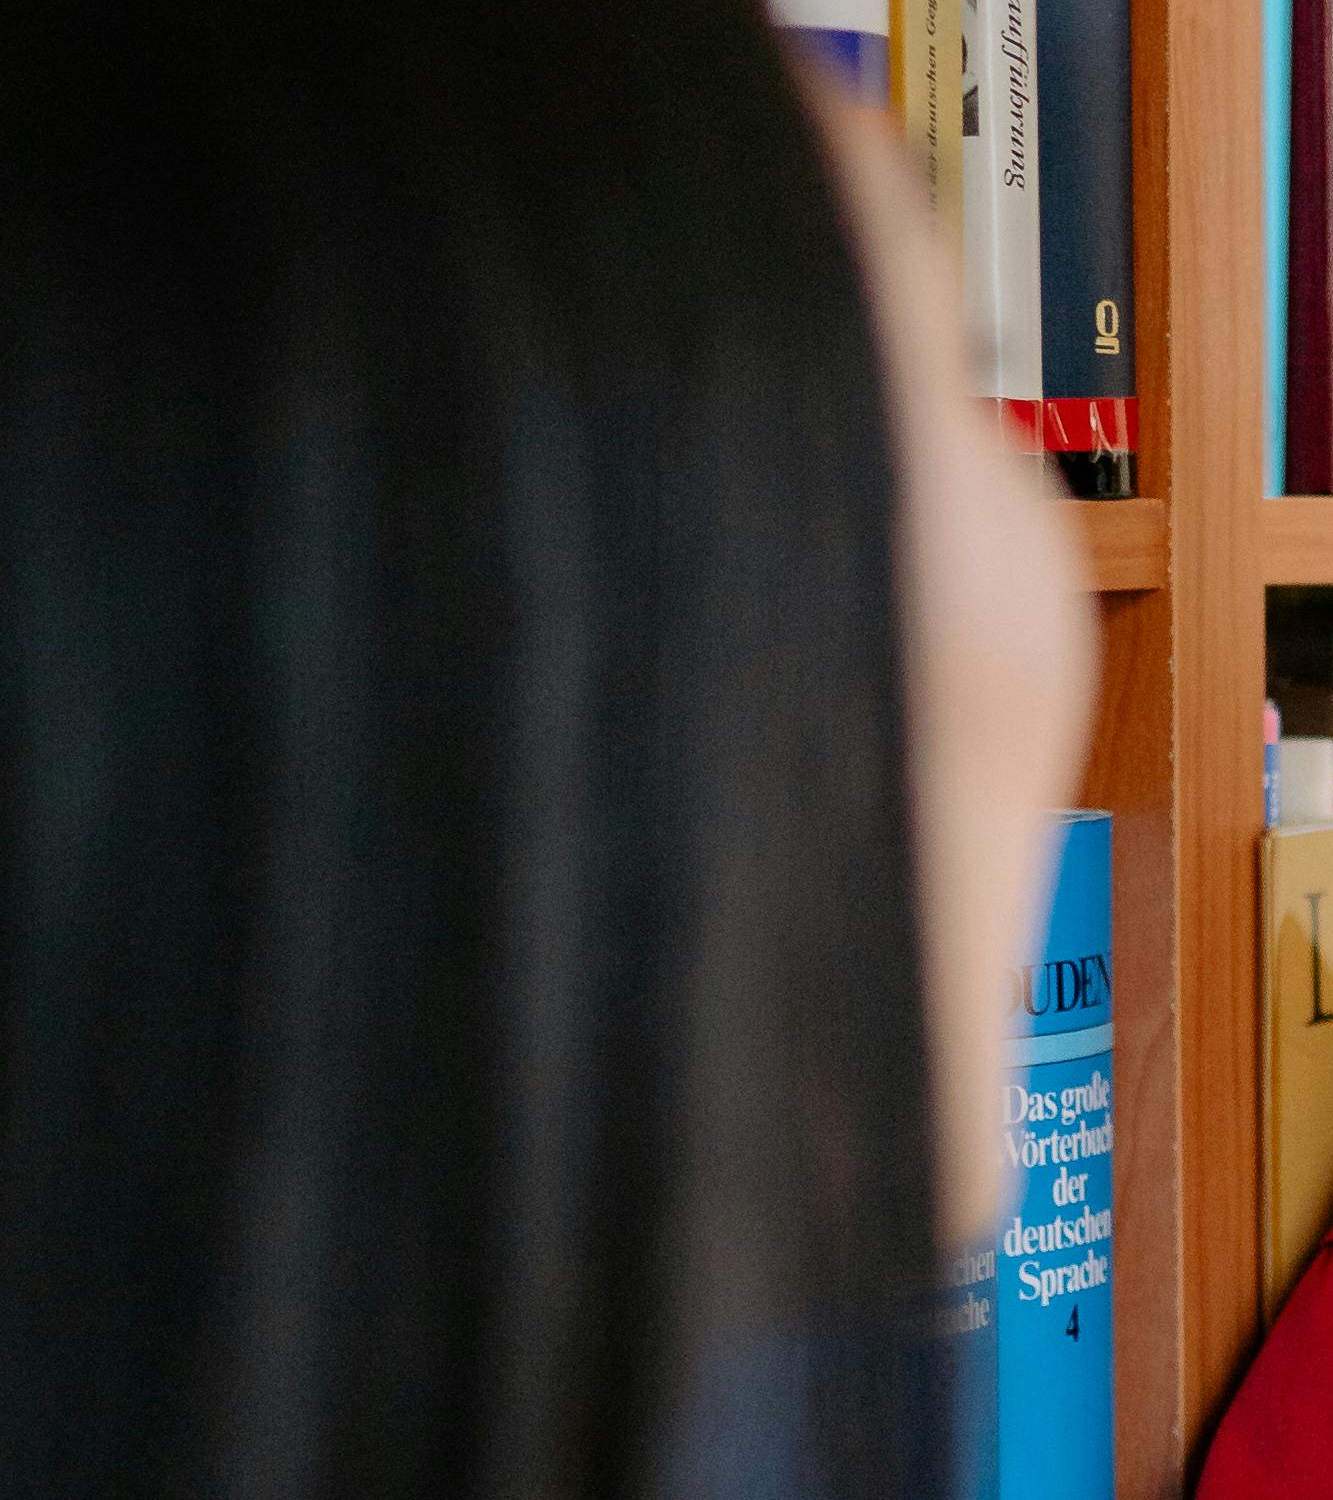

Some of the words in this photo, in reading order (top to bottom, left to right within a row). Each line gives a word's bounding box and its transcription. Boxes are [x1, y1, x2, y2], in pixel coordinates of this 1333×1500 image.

[924, 43, 938, 149] deutschen
[1001, 1083, 1059, 1125] Das
[1060, 1071, 1111, 1126] große
[1052, 1167, 1089, 1207] der
[1003, 1206, 1112, 1258] deutschen
[1017, 1248, 1108, 1307] Sprache
[1064, 1302, 1081, 1343] 4
